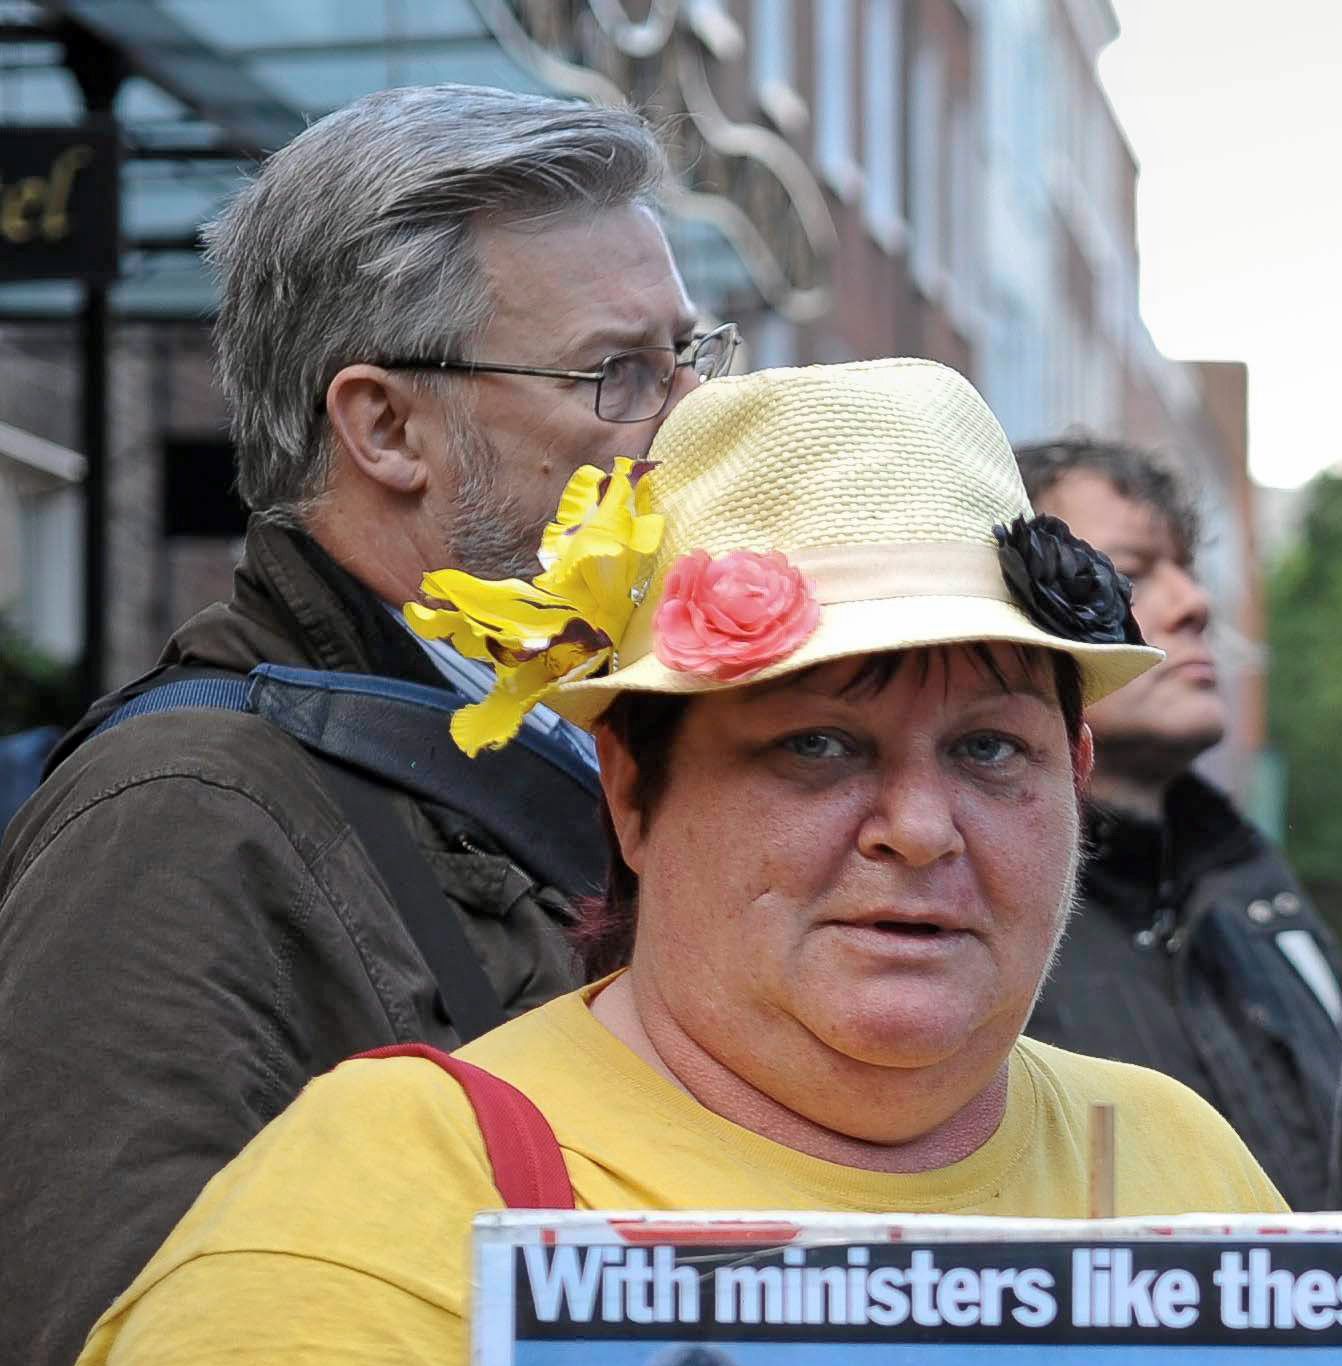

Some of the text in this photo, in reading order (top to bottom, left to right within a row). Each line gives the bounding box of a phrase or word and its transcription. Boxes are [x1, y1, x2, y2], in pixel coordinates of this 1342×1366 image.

[521, 1244, 700, 1324] With
[714, 1245, 1057, 1329] ministers
[1071, 1246, 1202, 1330] like
